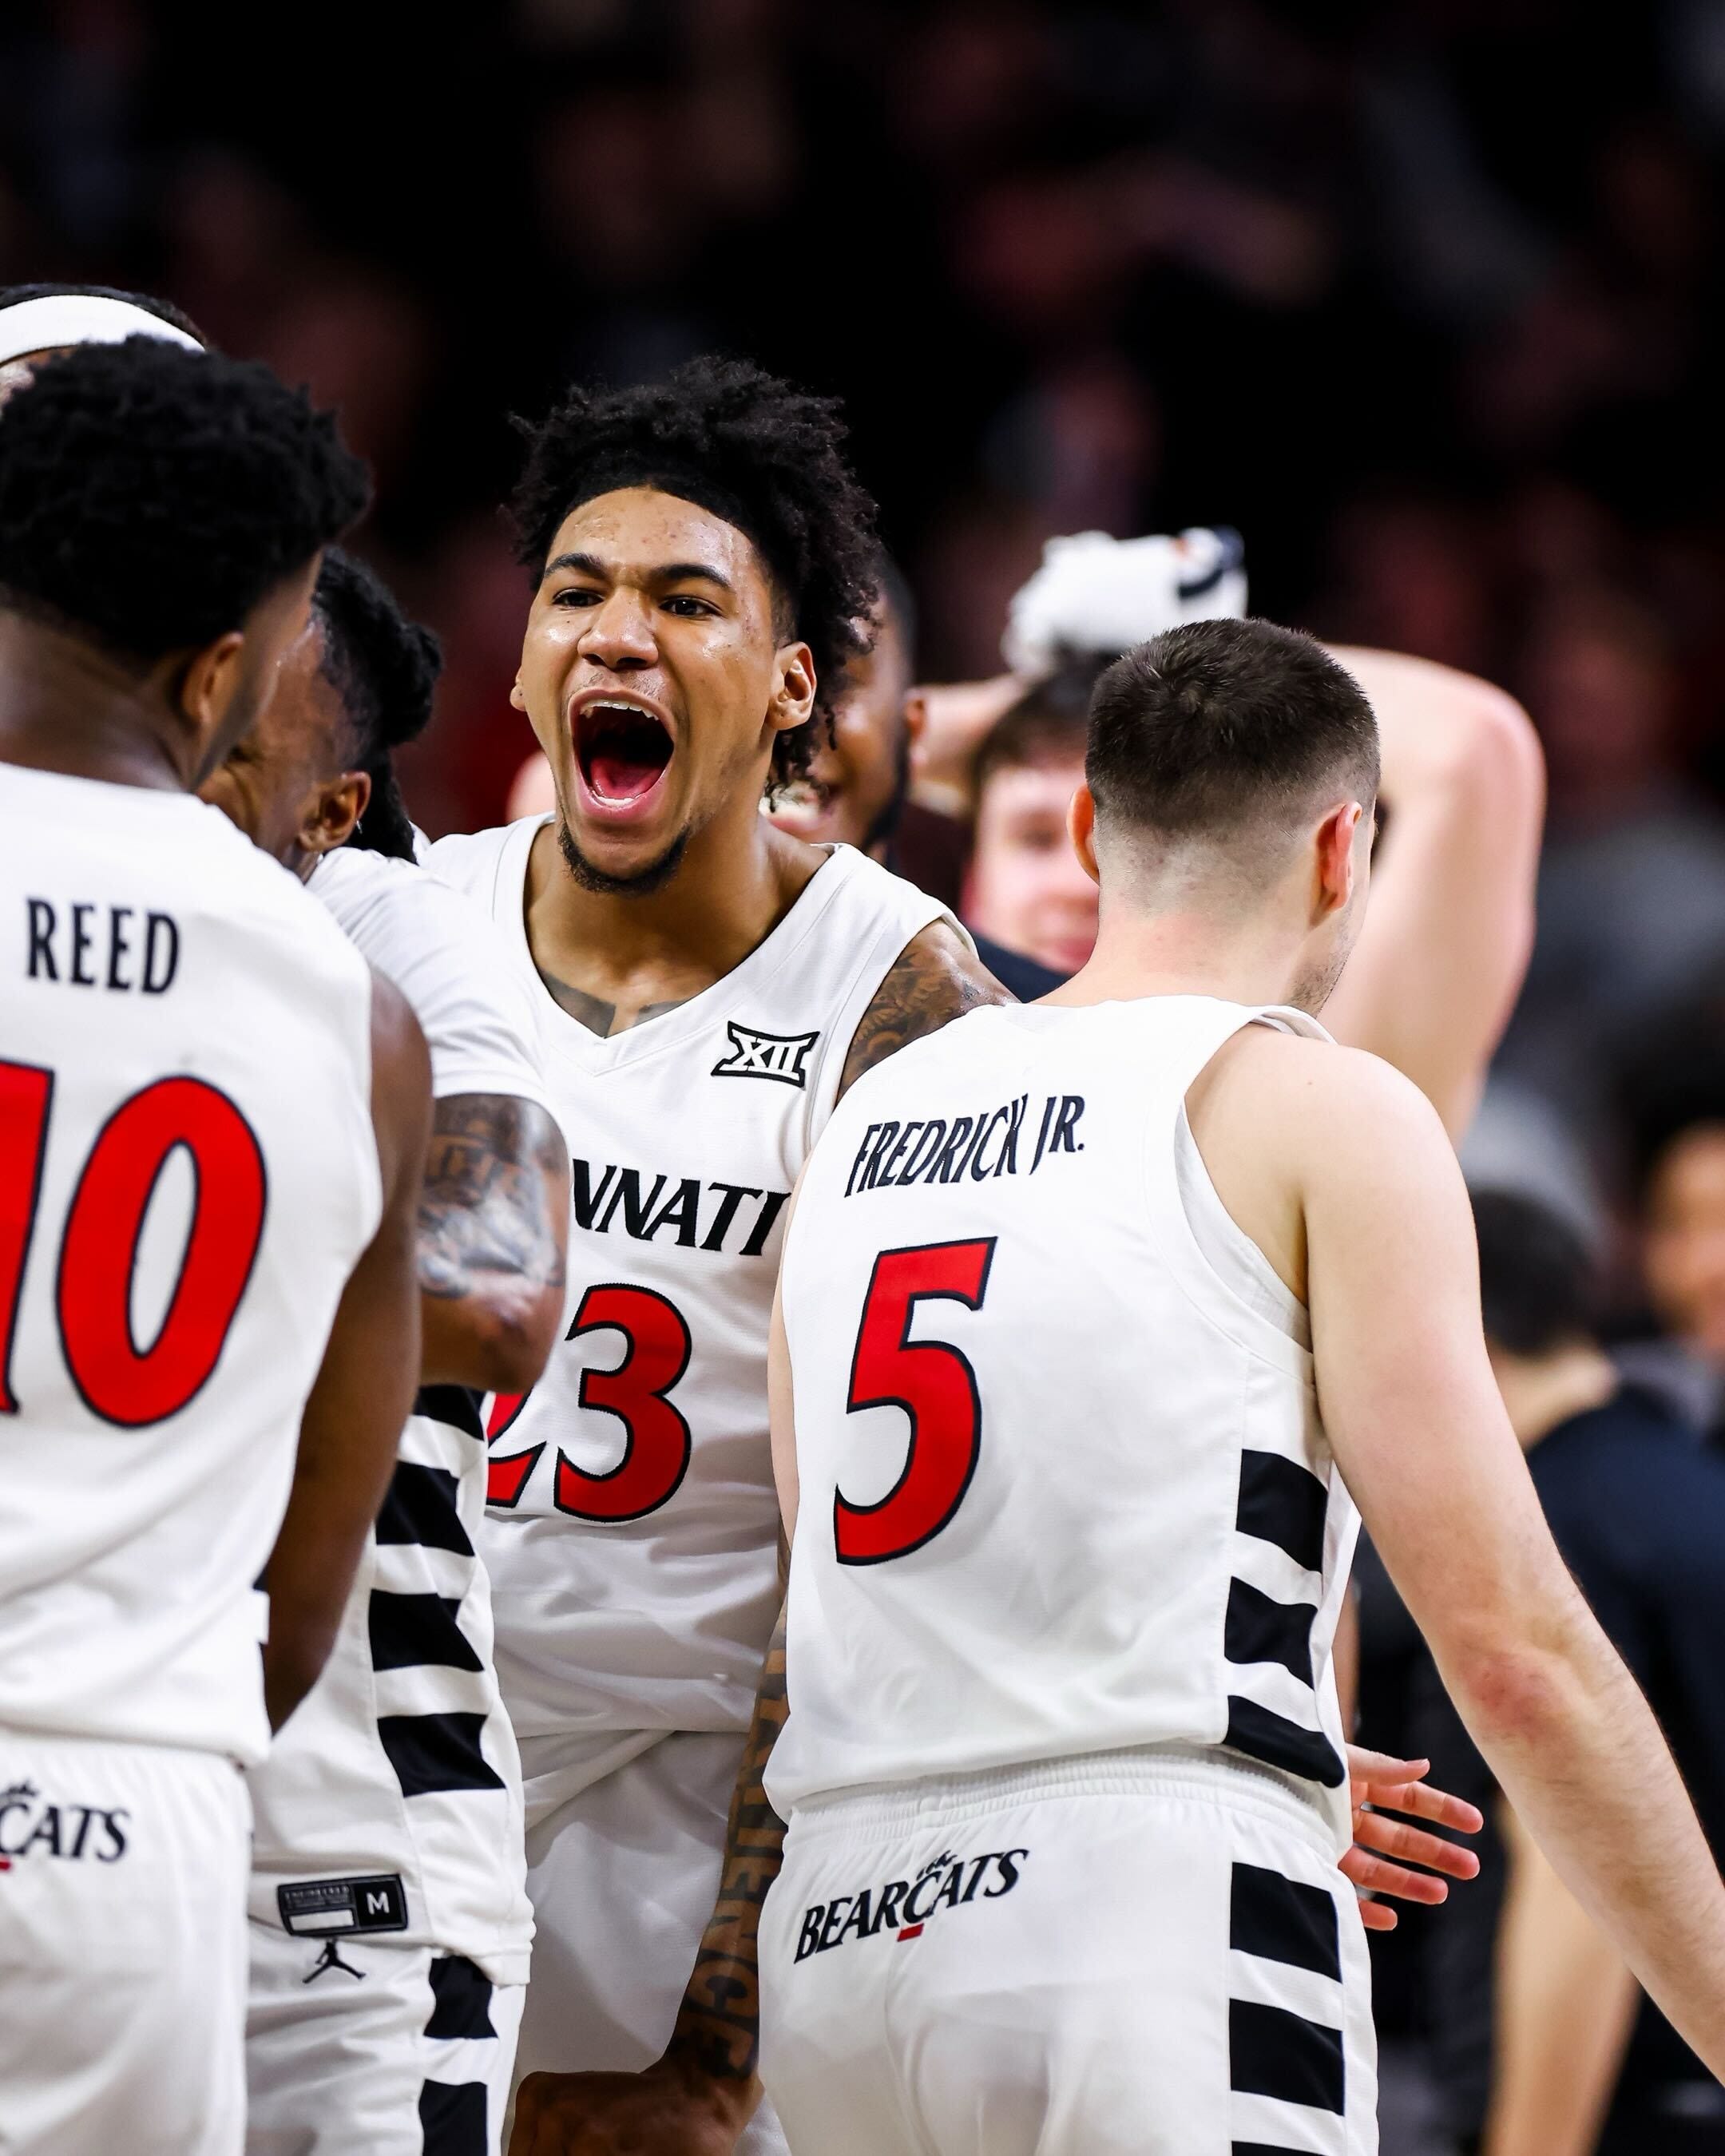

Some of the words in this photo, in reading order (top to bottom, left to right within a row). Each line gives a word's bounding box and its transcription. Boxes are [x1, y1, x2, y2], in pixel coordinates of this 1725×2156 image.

[26, 898, 180, 995] REED
[712, 1022, 818, 1086] XII
[843, 1092, 1028, 1198] FREDRICK
[1029, 1095, 1085, 1175] JR.
[833, 1236, 997, 1567] 5
[366, 1891, 390, 1915] M
[793, 1849, 1029, 1964] BEARCATS
